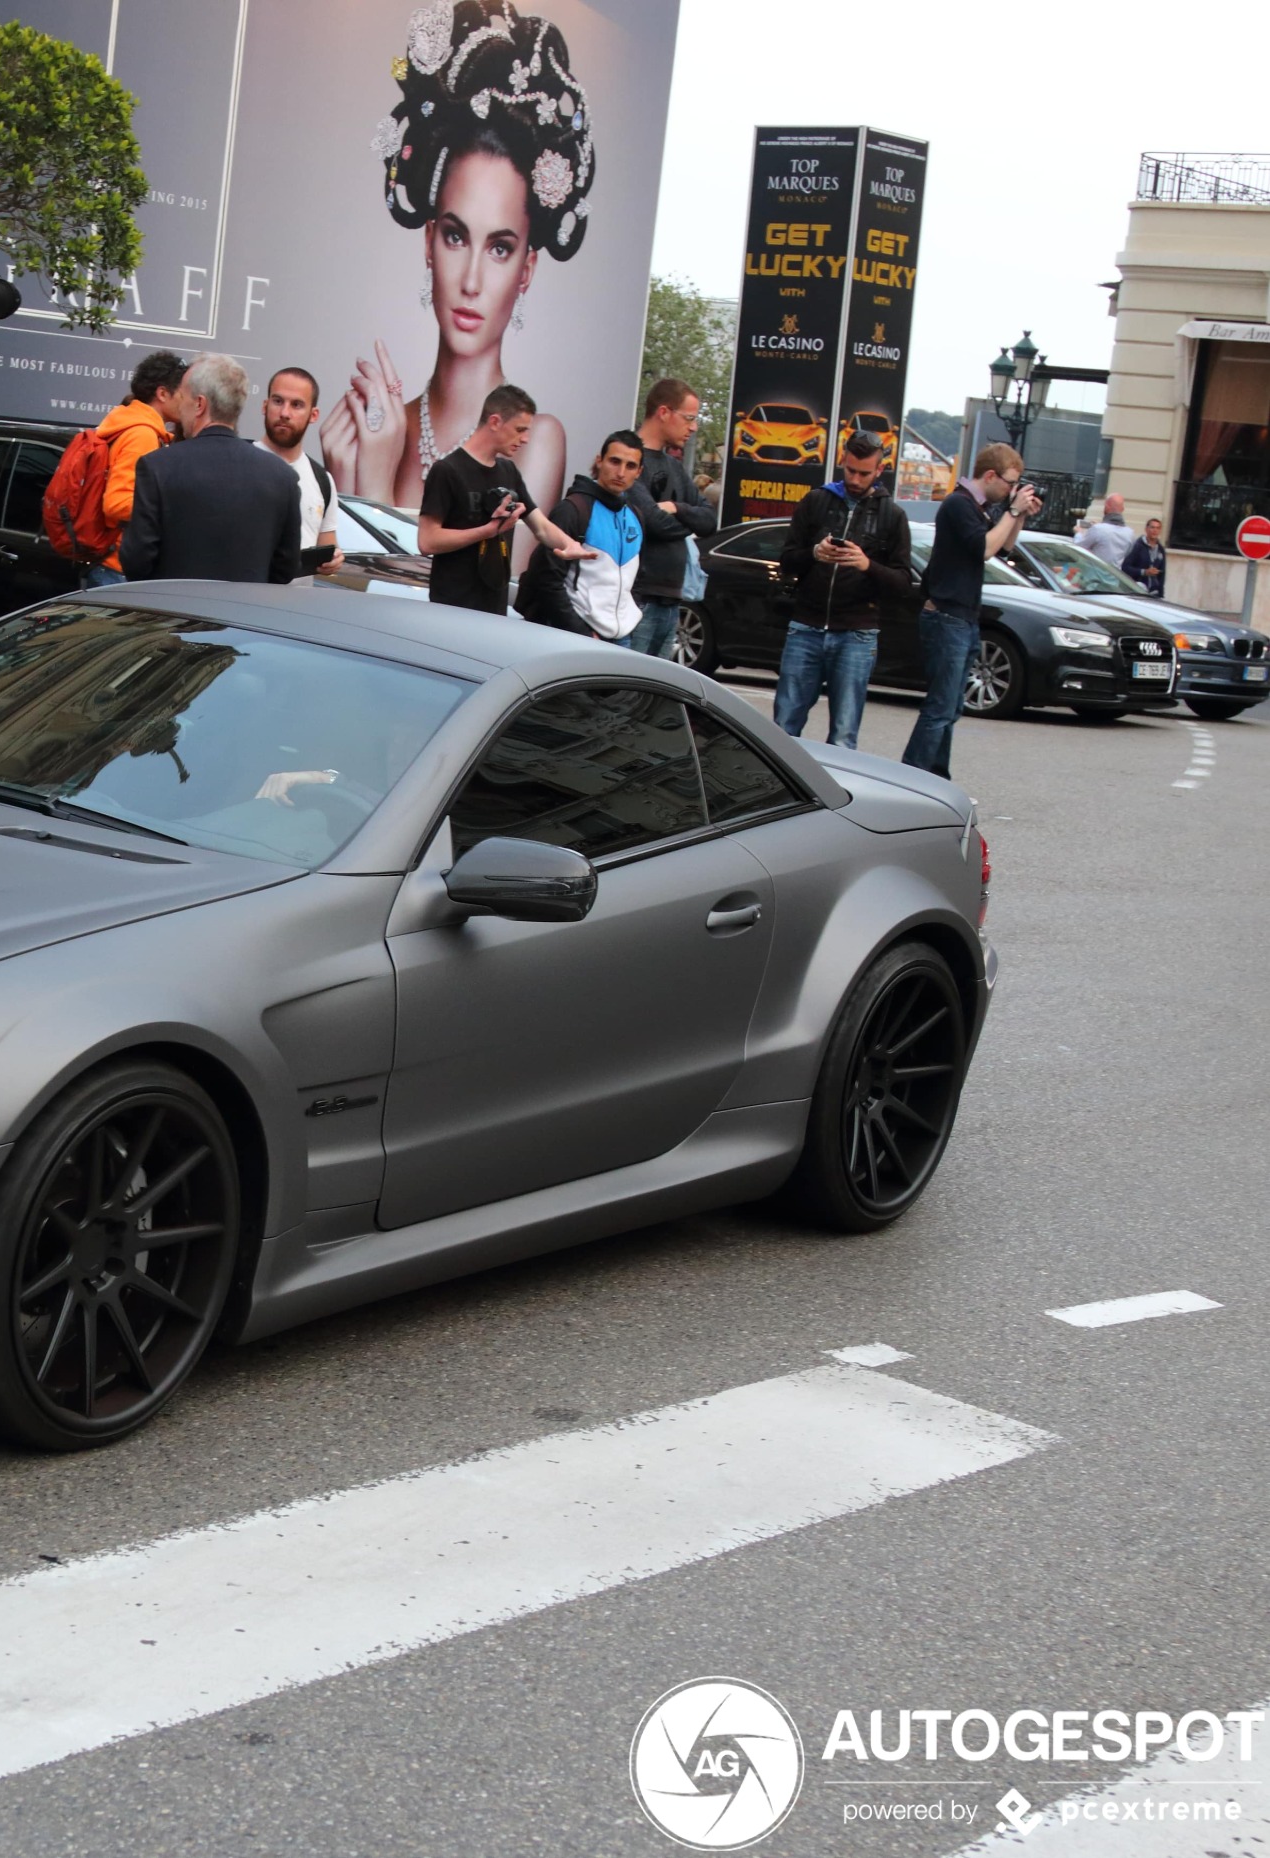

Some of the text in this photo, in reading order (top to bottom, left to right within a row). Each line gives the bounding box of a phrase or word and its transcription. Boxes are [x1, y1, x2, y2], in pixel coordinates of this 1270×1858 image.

[790, 159, 820, 173] TOP
[885, 166, 905, 183] TOP
[767, 176, 840, 193] MARQUES
[869, 181, 917, 203] MARQUES
[151, 190, 208, 211] ING 2015
[778, 195, 828, 203] MONACO
[766, 223, 832, 247] GET
[867, 229, 909, 257] GET
[745, 252, 847, 278] LUCKY
[852, 257, 917, 290] LUCKY
[1208, 323, 1236, 338] Bar
[751, 335, 824, 352] LE CASINO
[853, 342, 901, 361] LE CASINO
[9, 356, 45, 372] MOST
[50, 362, 116, 379] FABULOUS
[740, 479, 783, 500] SUPERCAR
